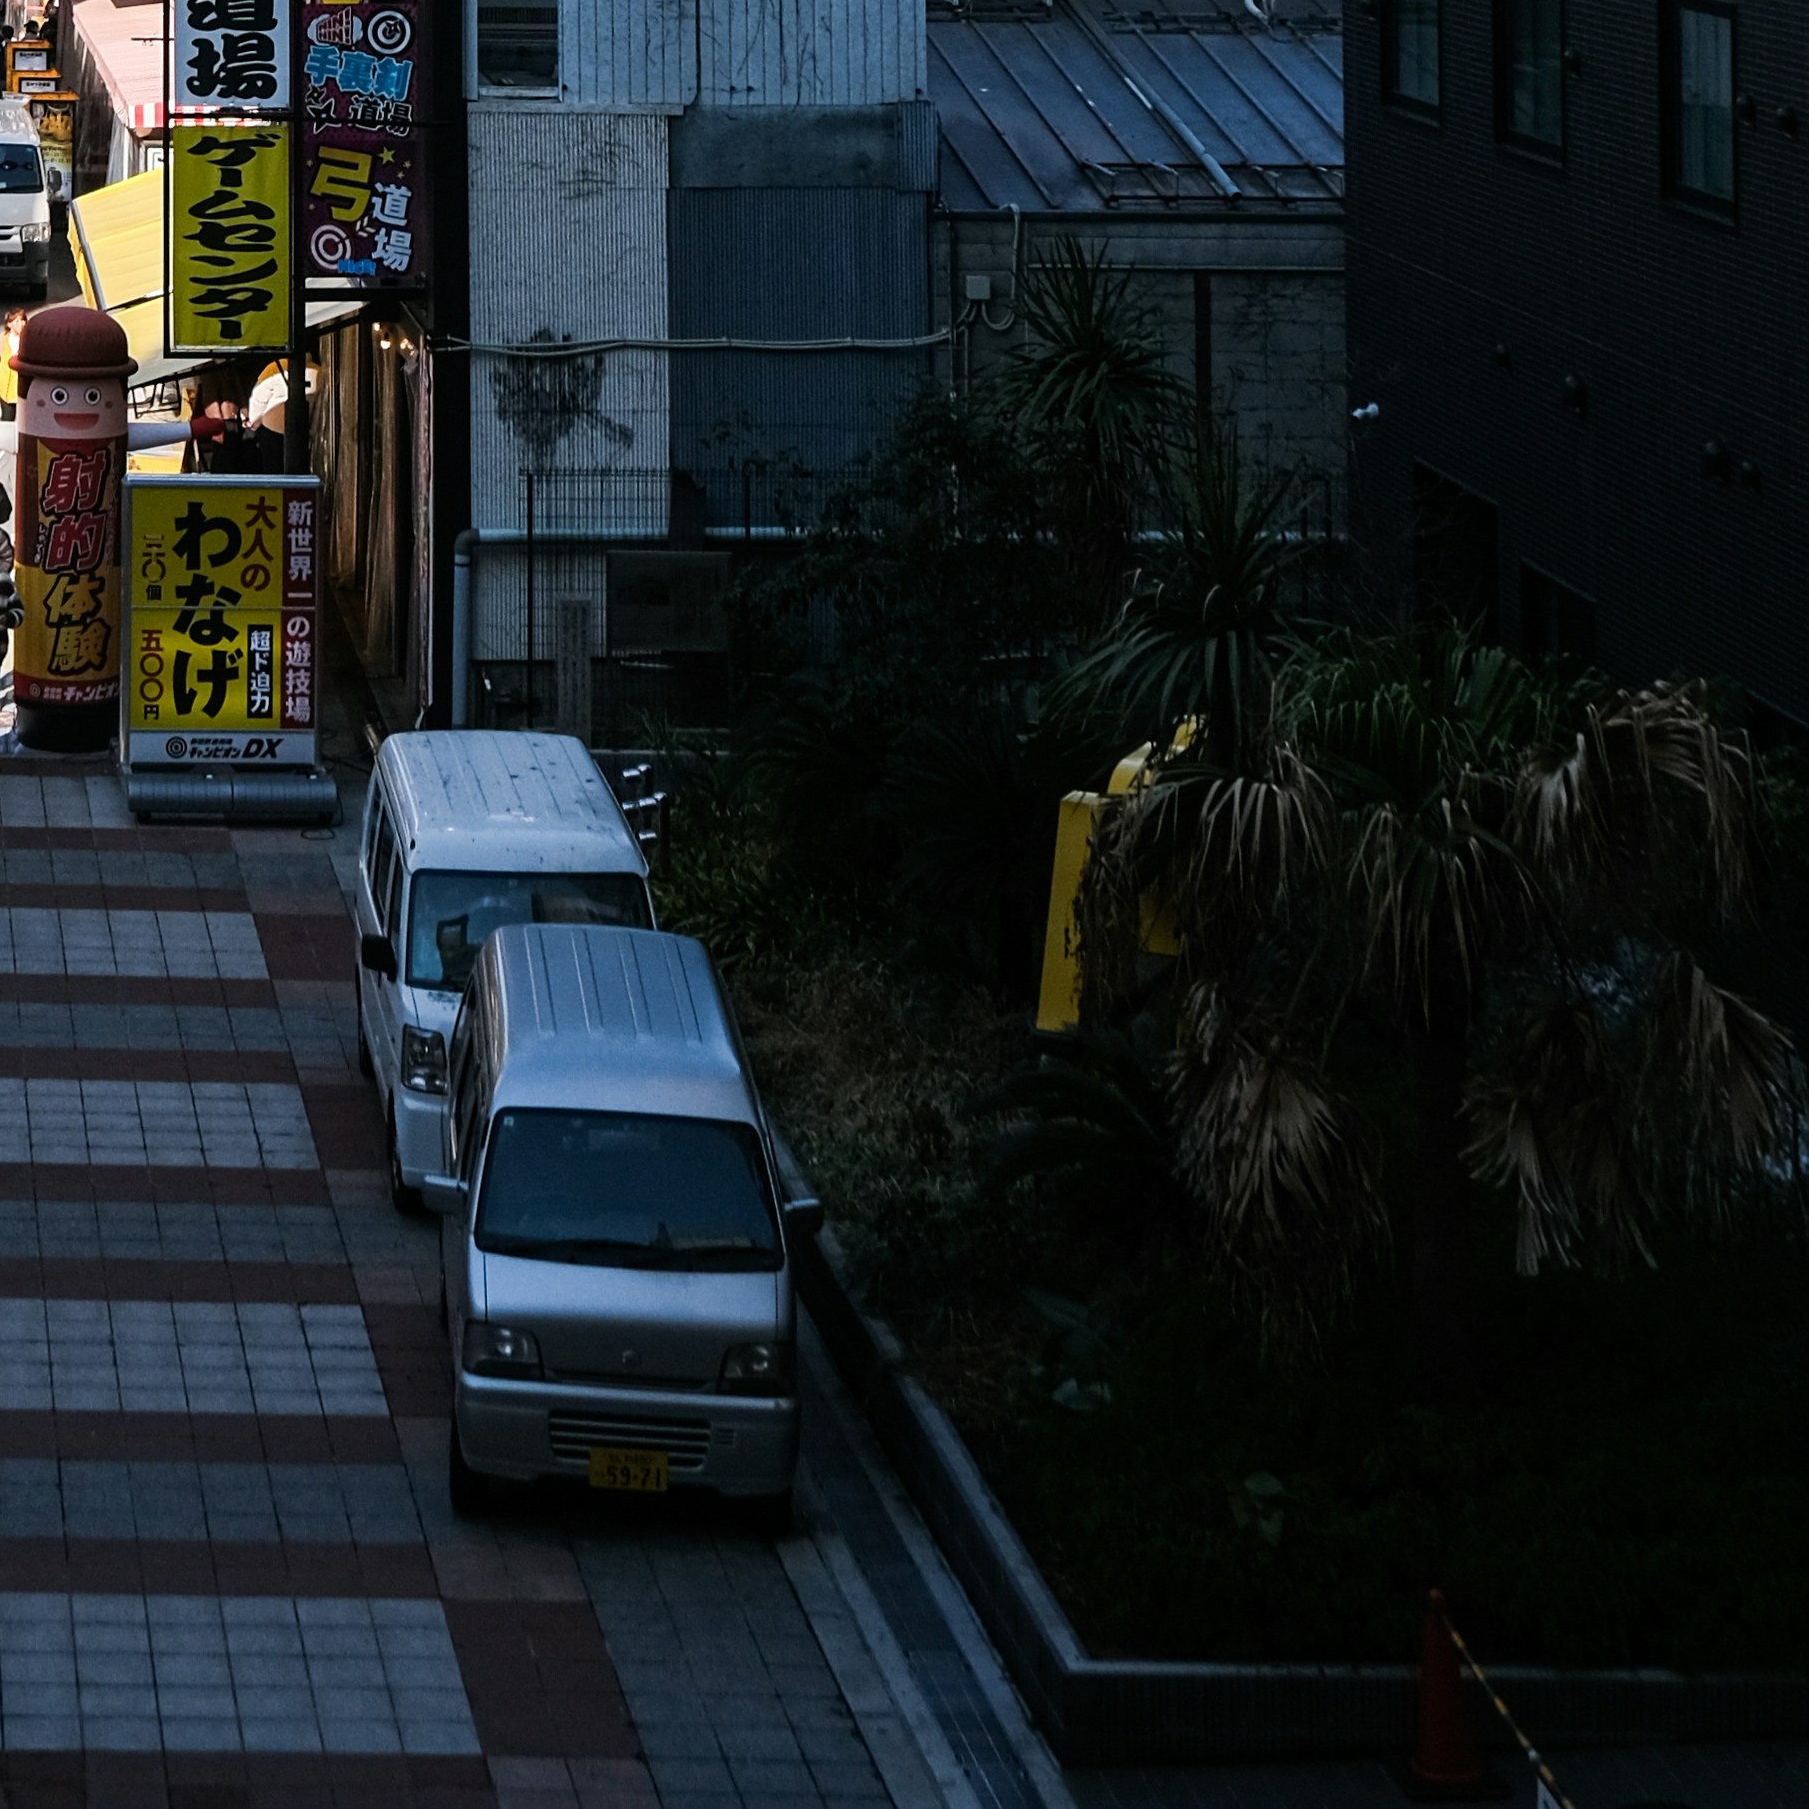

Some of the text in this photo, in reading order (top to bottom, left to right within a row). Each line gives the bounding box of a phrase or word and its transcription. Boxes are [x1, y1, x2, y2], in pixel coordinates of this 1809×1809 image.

[304, 45, 413, 100] 手裏剣
[348, 95, 412, 137] 道場
[309, 145, 373, 223] 弓
[371, 181, 412, 273] 道場
[187, 134, 278, 341] ゲームセンター
[42, 448, 112, 676] 射的体験
[240, 495, 278, 592] 大人の
[172, 501, 244, 719] わなげ
[285, 500, 314, 723] 新世界一の遊技場
[139, 629, 165, 721] 五〇〇円
[250, 630, 272, 714] 超ド迫力
[241, 738, 285, 759] DX
